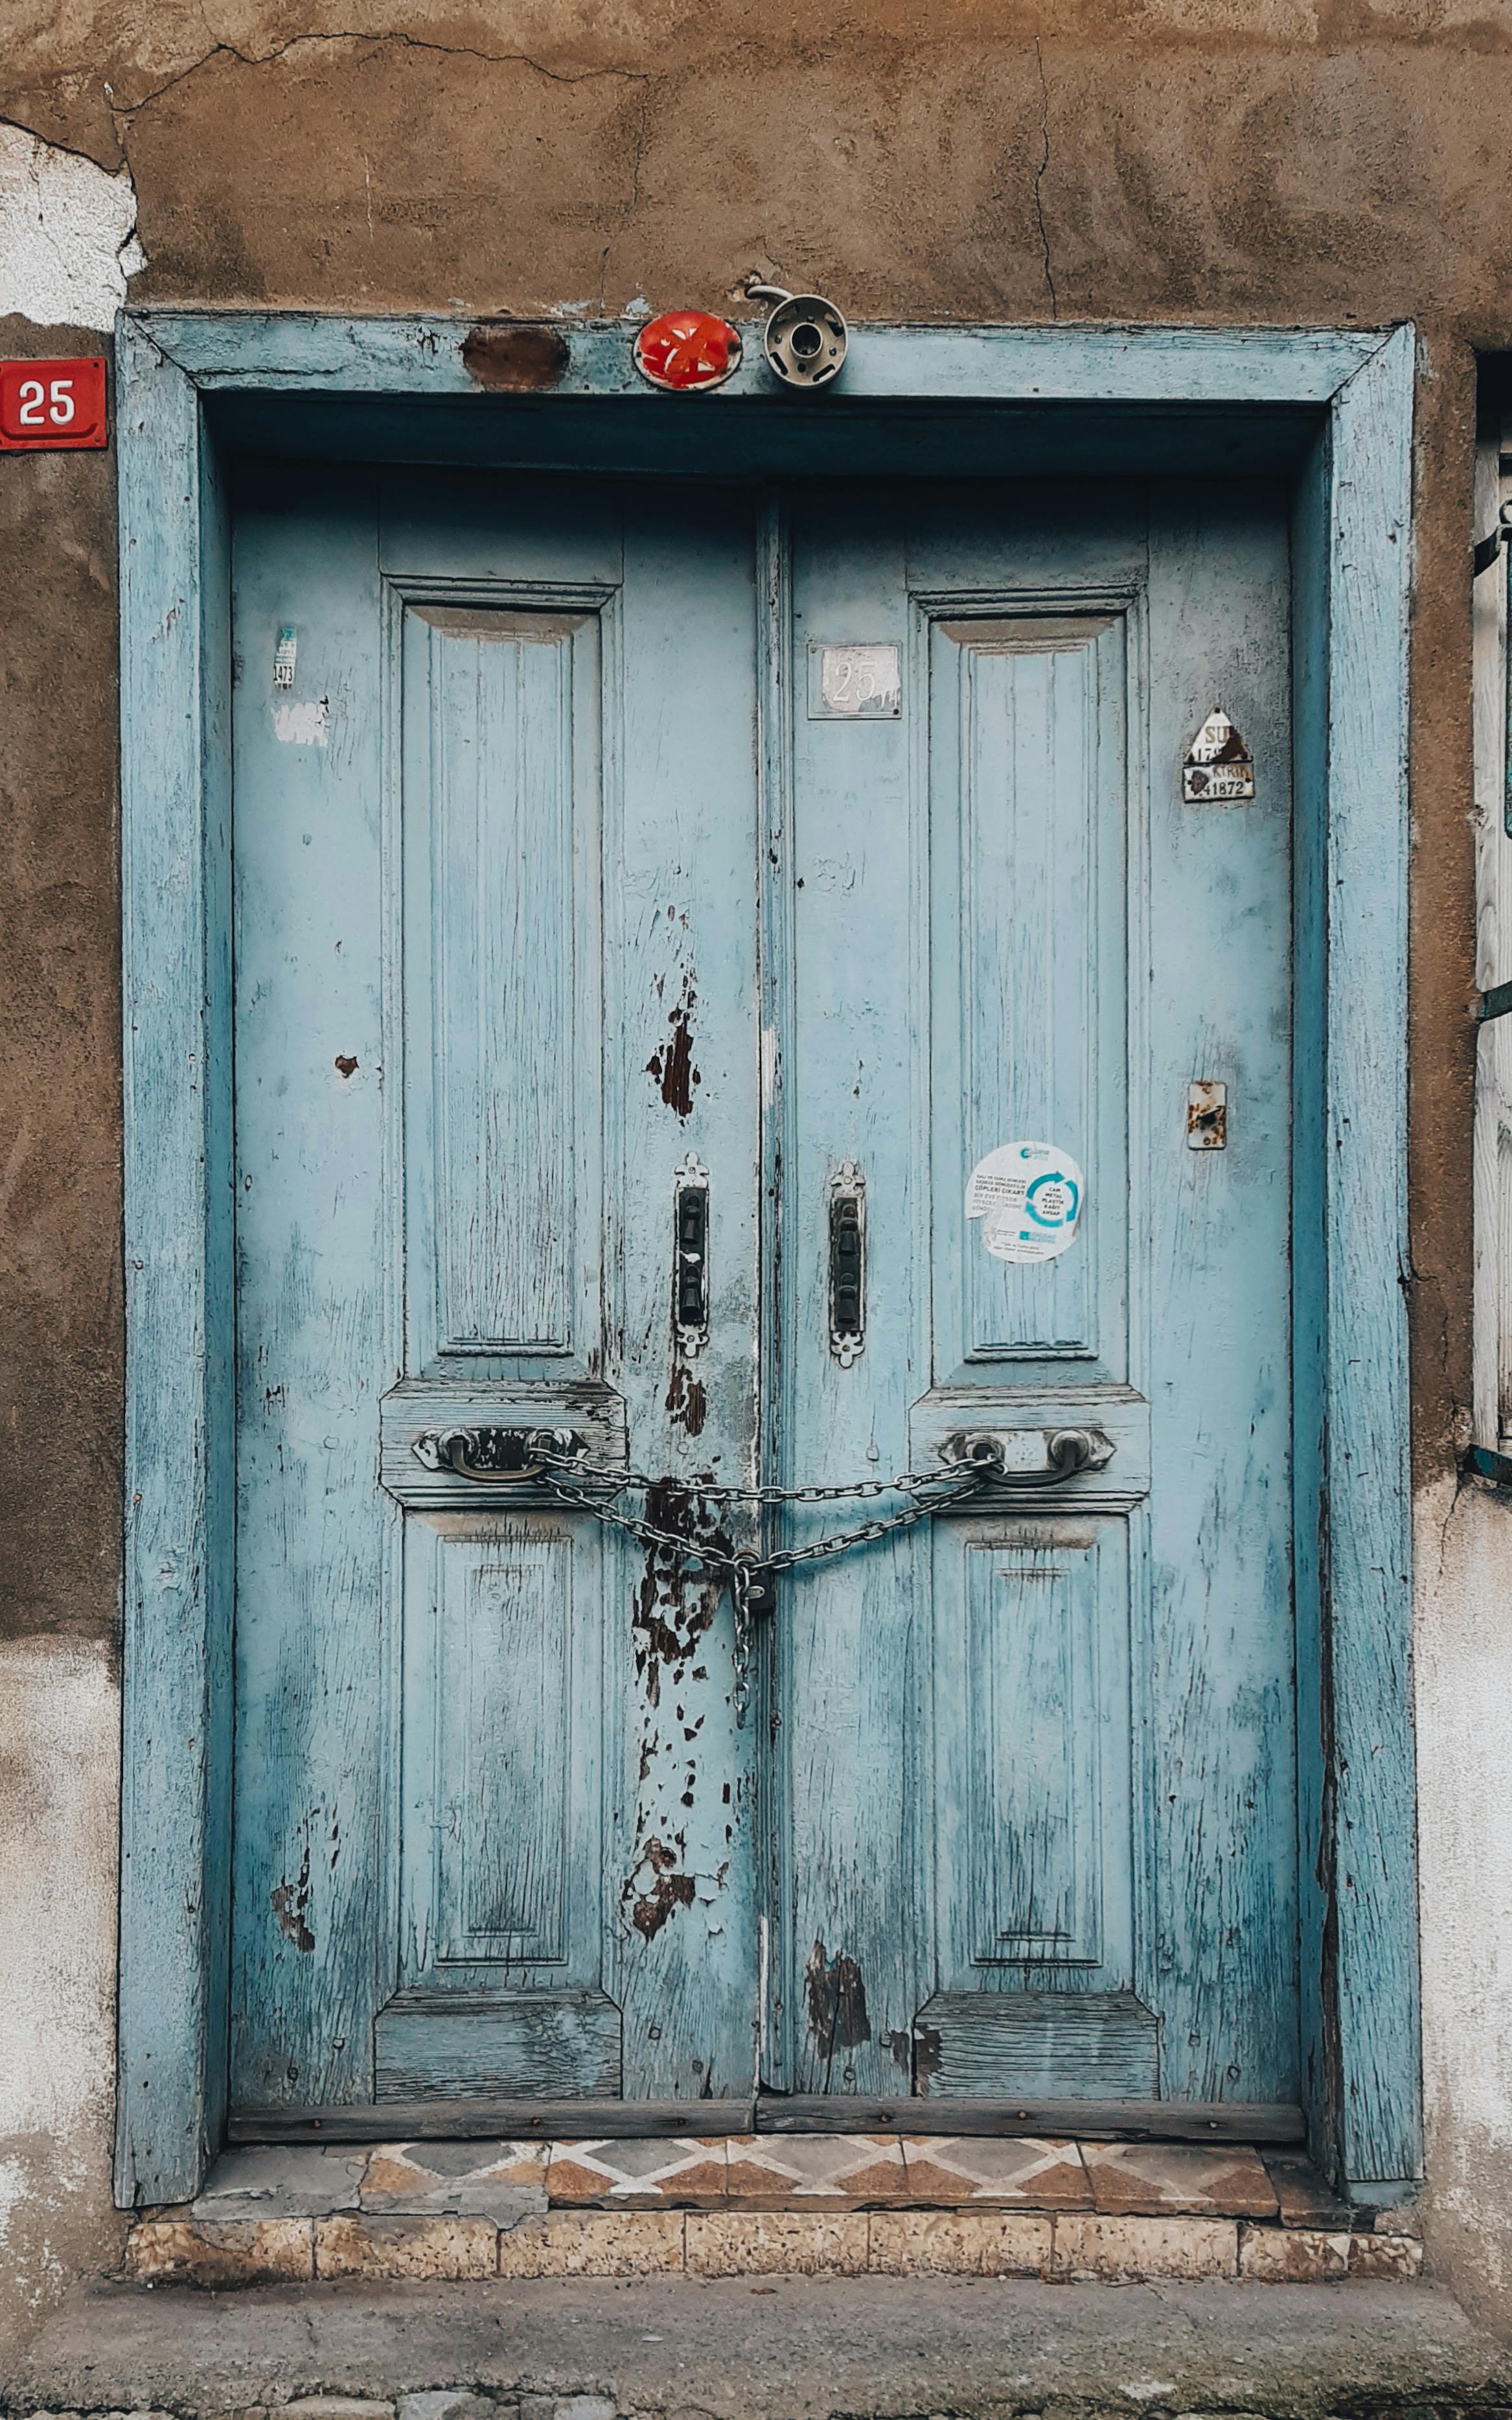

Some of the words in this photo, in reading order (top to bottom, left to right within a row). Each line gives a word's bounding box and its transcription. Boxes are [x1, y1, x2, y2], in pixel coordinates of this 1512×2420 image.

[19, 380, 74, 425] 25
[273, 665, 293, 682] 1473
[833, 660, 875, 701] 25
[1206, 726, 1230, 744] SU
